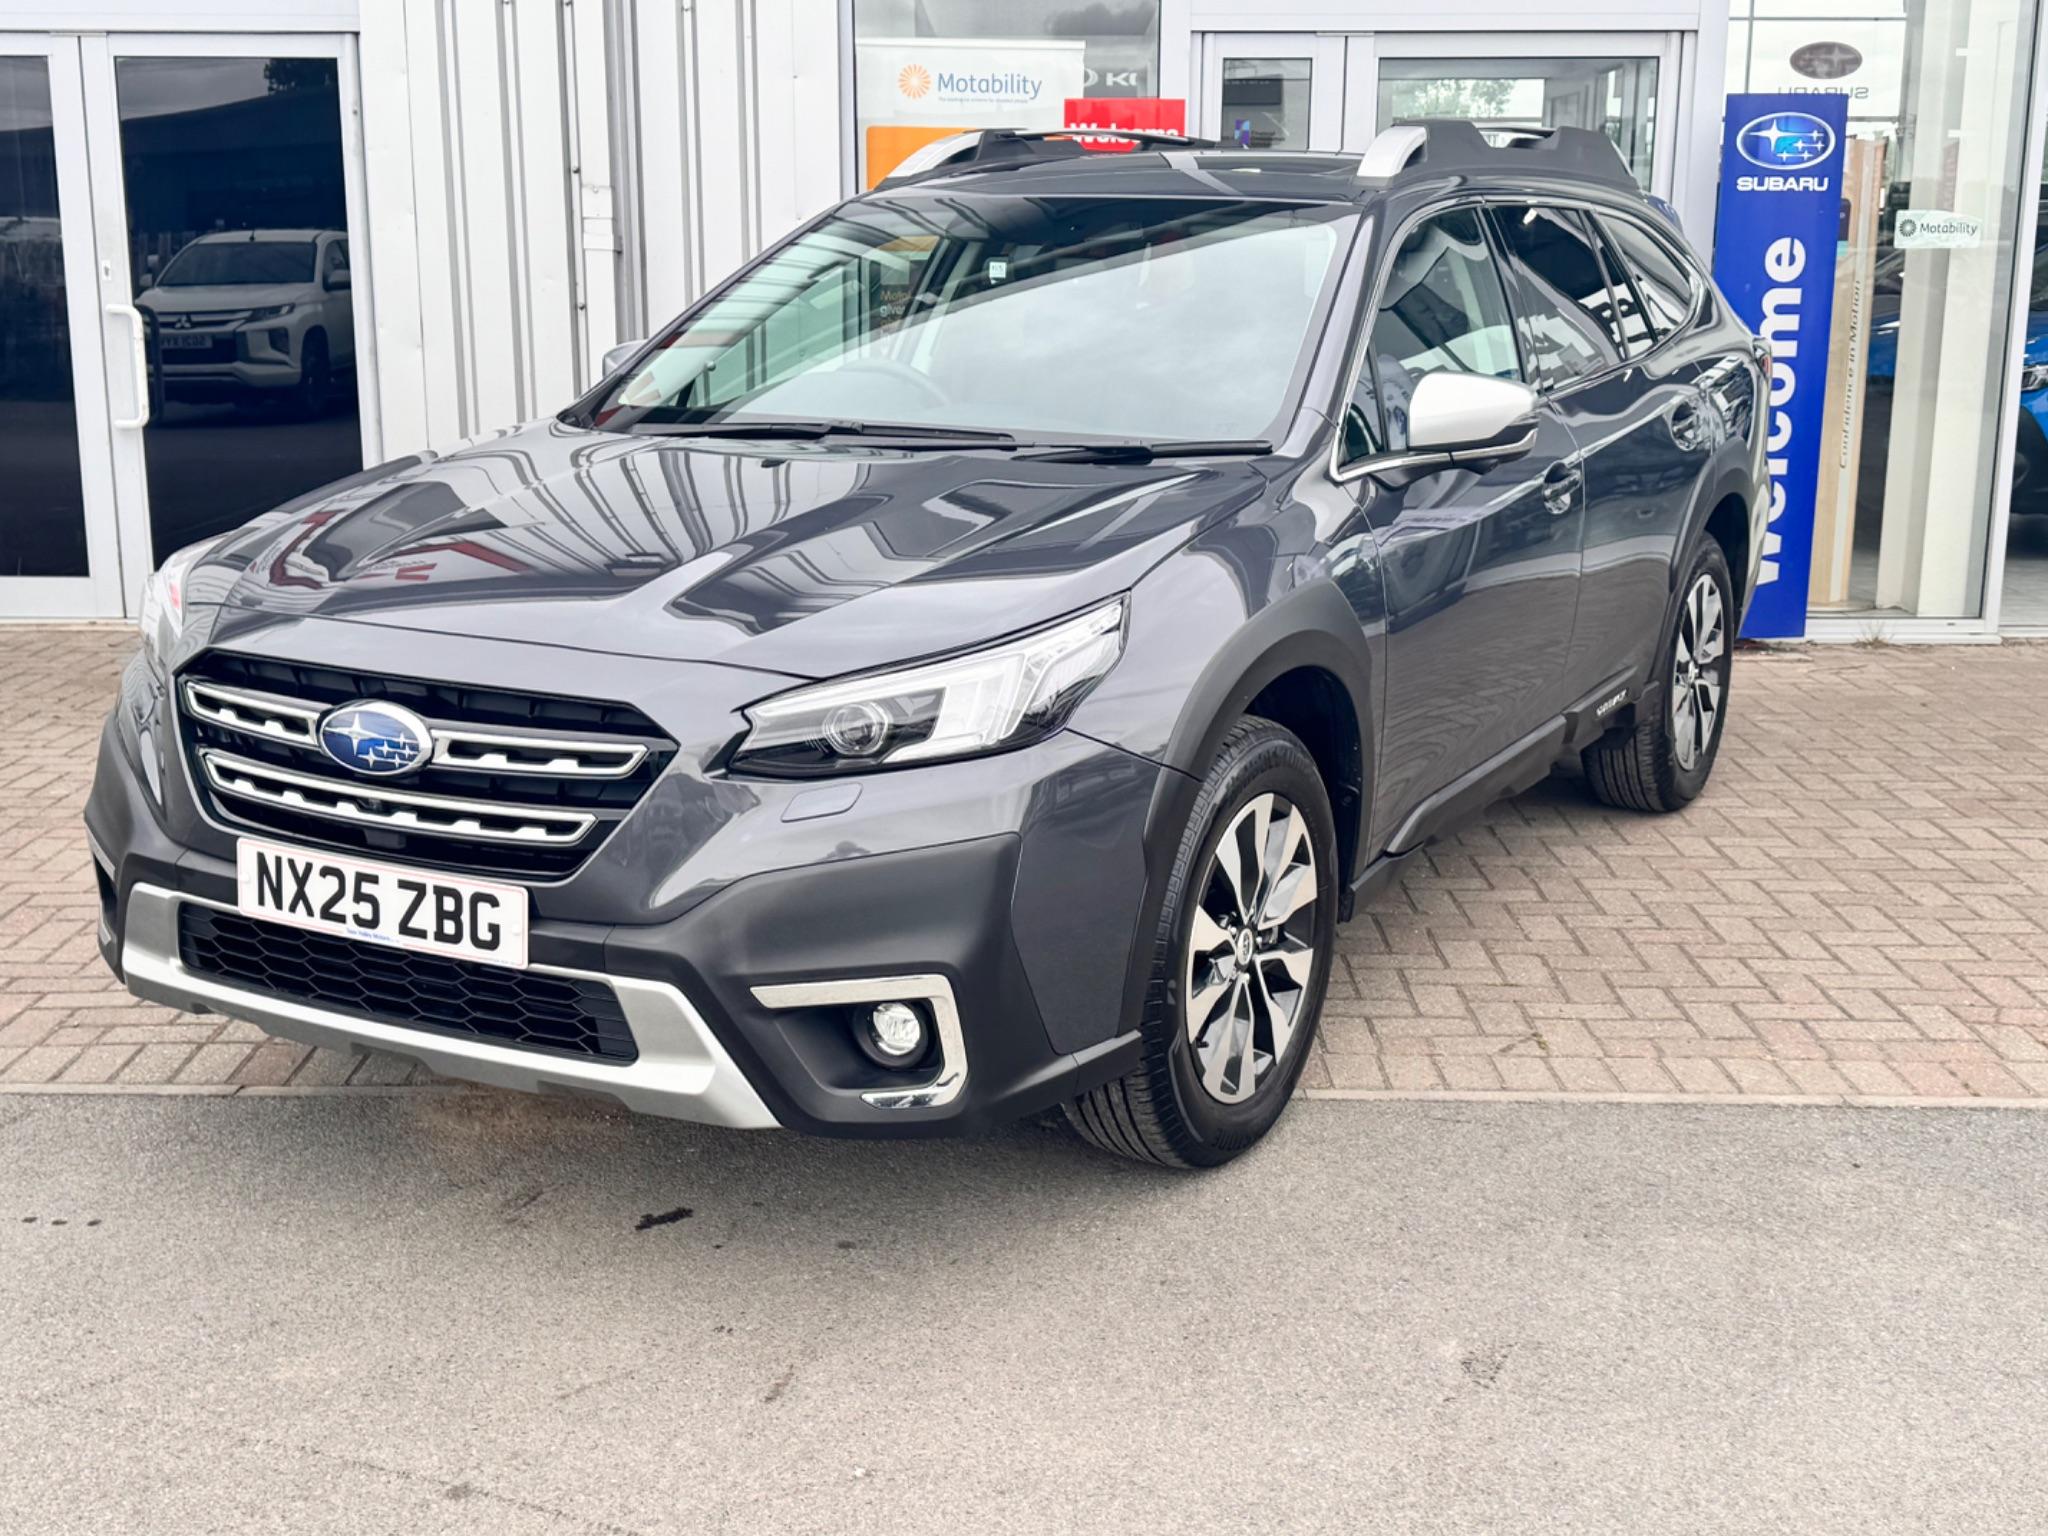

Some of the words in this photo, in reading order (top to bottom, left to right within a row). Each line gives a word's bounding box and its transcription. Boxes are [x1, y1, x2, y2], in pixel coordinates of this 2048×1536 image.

[937, 73, 1042, 99] Motability
[1736, 176, 1829, 192] SUBARU
[1920, 222, 1978, 236] Motability
[256, 851, 380, 930] NX25
[397, 878, 501, 951] ZBG
